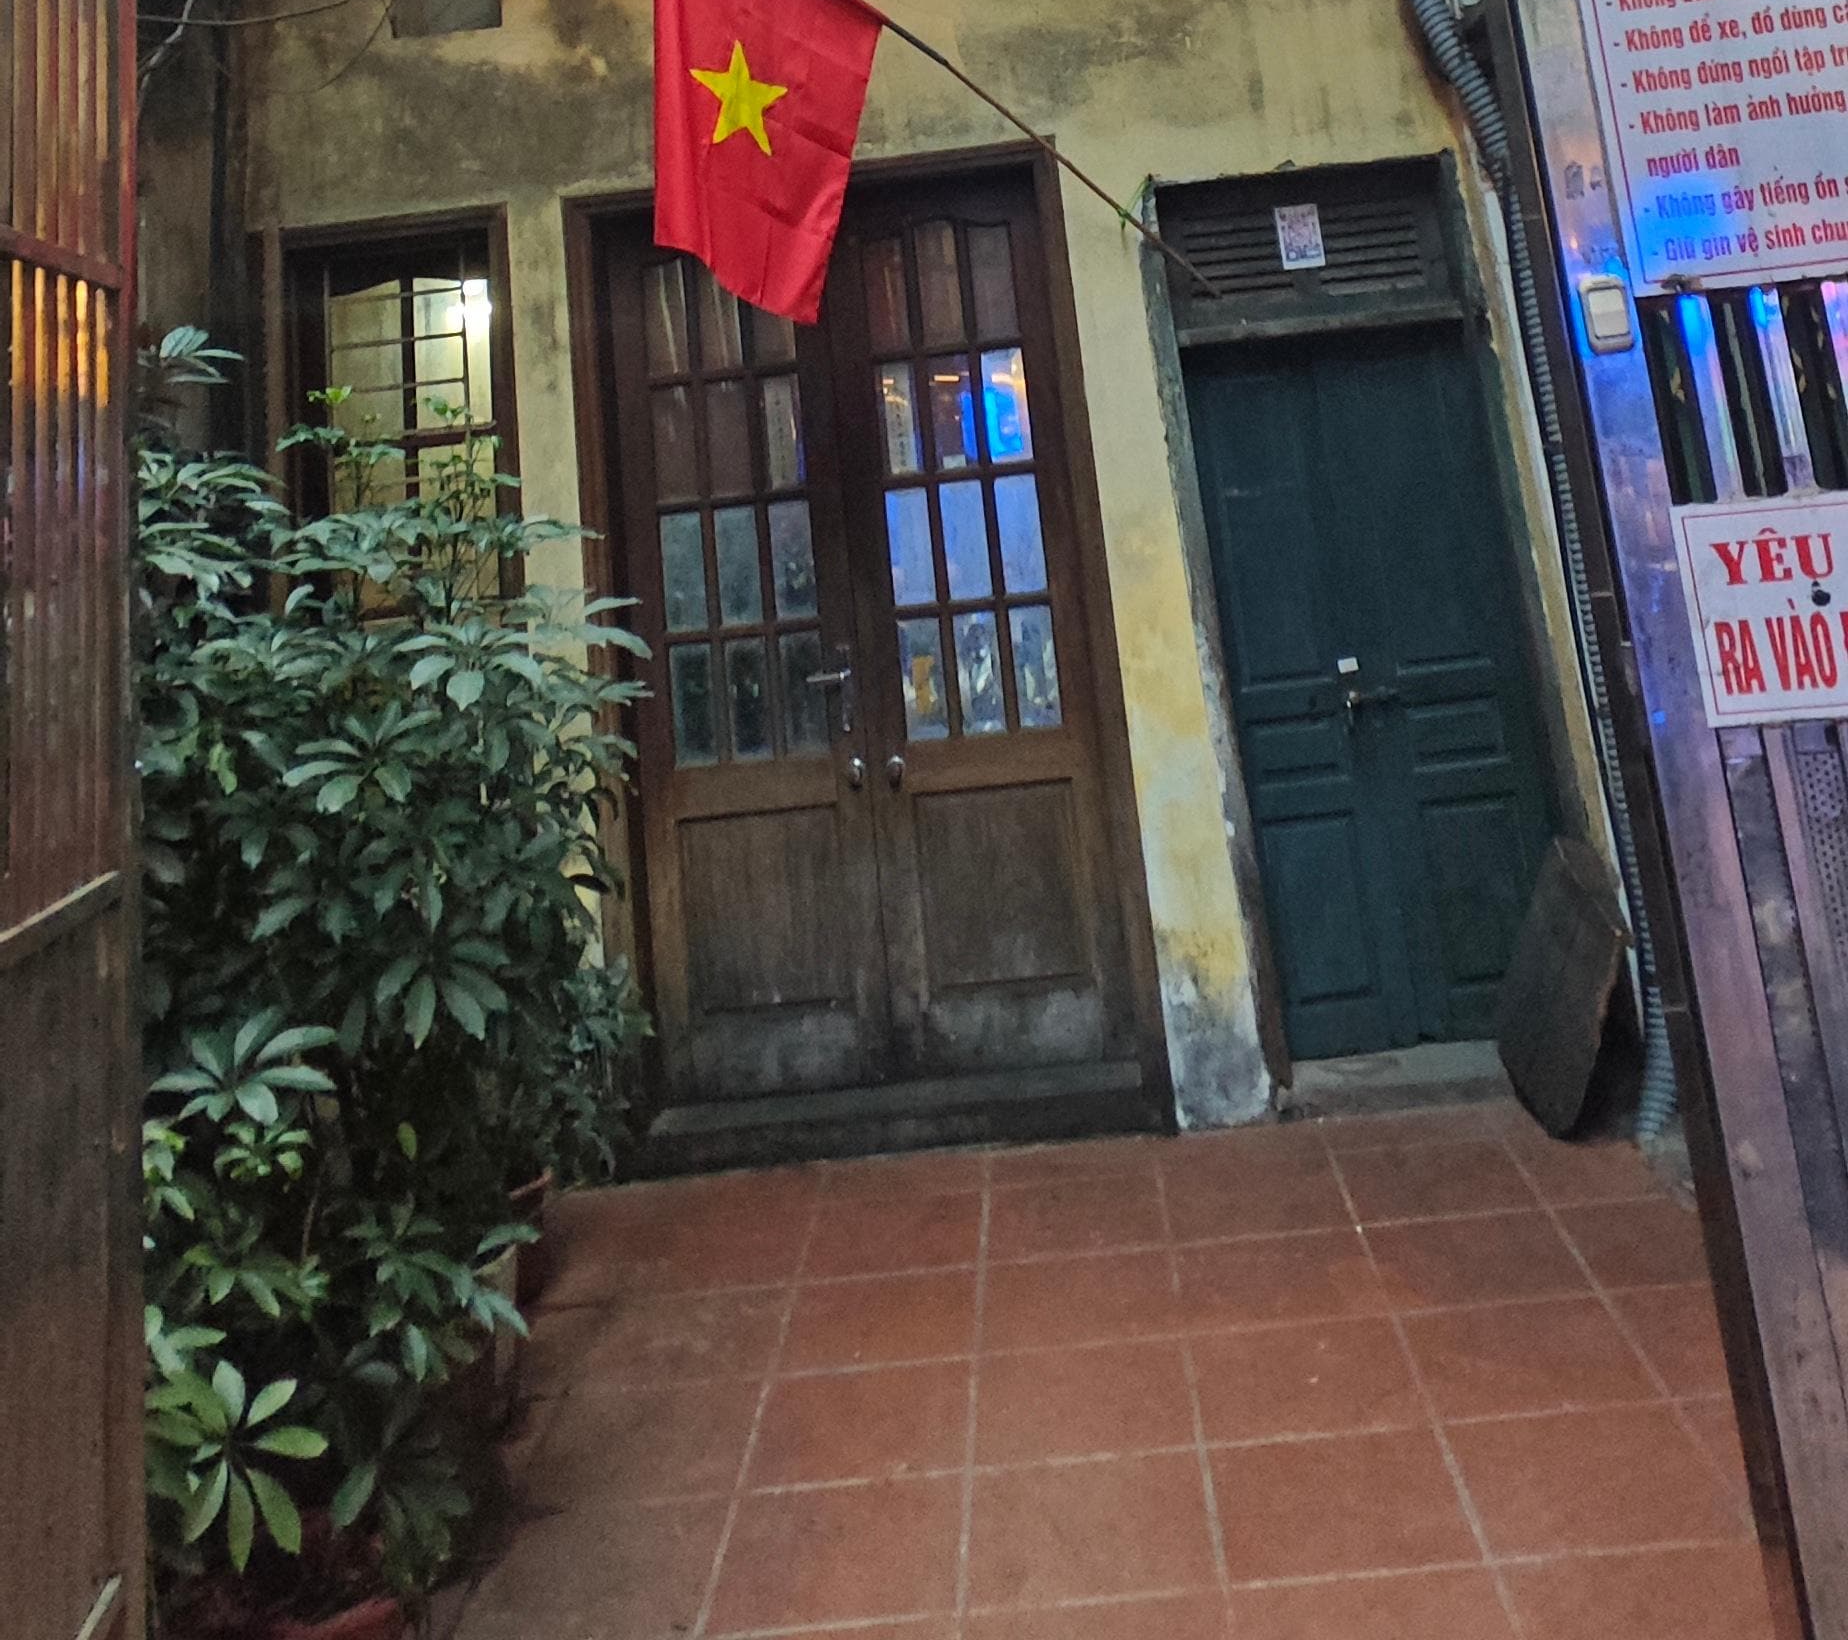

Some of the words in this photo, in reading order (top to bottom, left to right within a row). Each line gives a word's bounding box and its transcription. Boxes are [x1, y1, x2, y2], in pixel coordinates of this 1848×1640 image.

[1625, 25, 1684, 52] Không
[1717, 19, 1747, 40] xe,
[1780, 5, 1828, 31] dùng
[1632, 66, 1692, 94] Không
[1697, 59, 1743, 85] đứng
[1794, 45, 1826, 76] tập
[1830, 43, 1848, 67] tr
[1640, 107, 1700, 135] Không
[1704, 101, 1742, 127] làm
[1646, 147, 1700, 178] người
[1705, 143, 1741, 170] dân
[1655, 192, 1716, 219] Không
[1721, 185, 1754, 214] gây
[1760, 175, 1810, 206] tiếng
[1736, 227, 1759, 257] vệ
[1765, 223, 1806, 250] sinh
[1811, 219, 1848, 244] chu
[1709, 527, 1834, 586] YÊU
[1714, 619, 1767, 696] RA
[1764, 598, 1838, 691] VÀO
